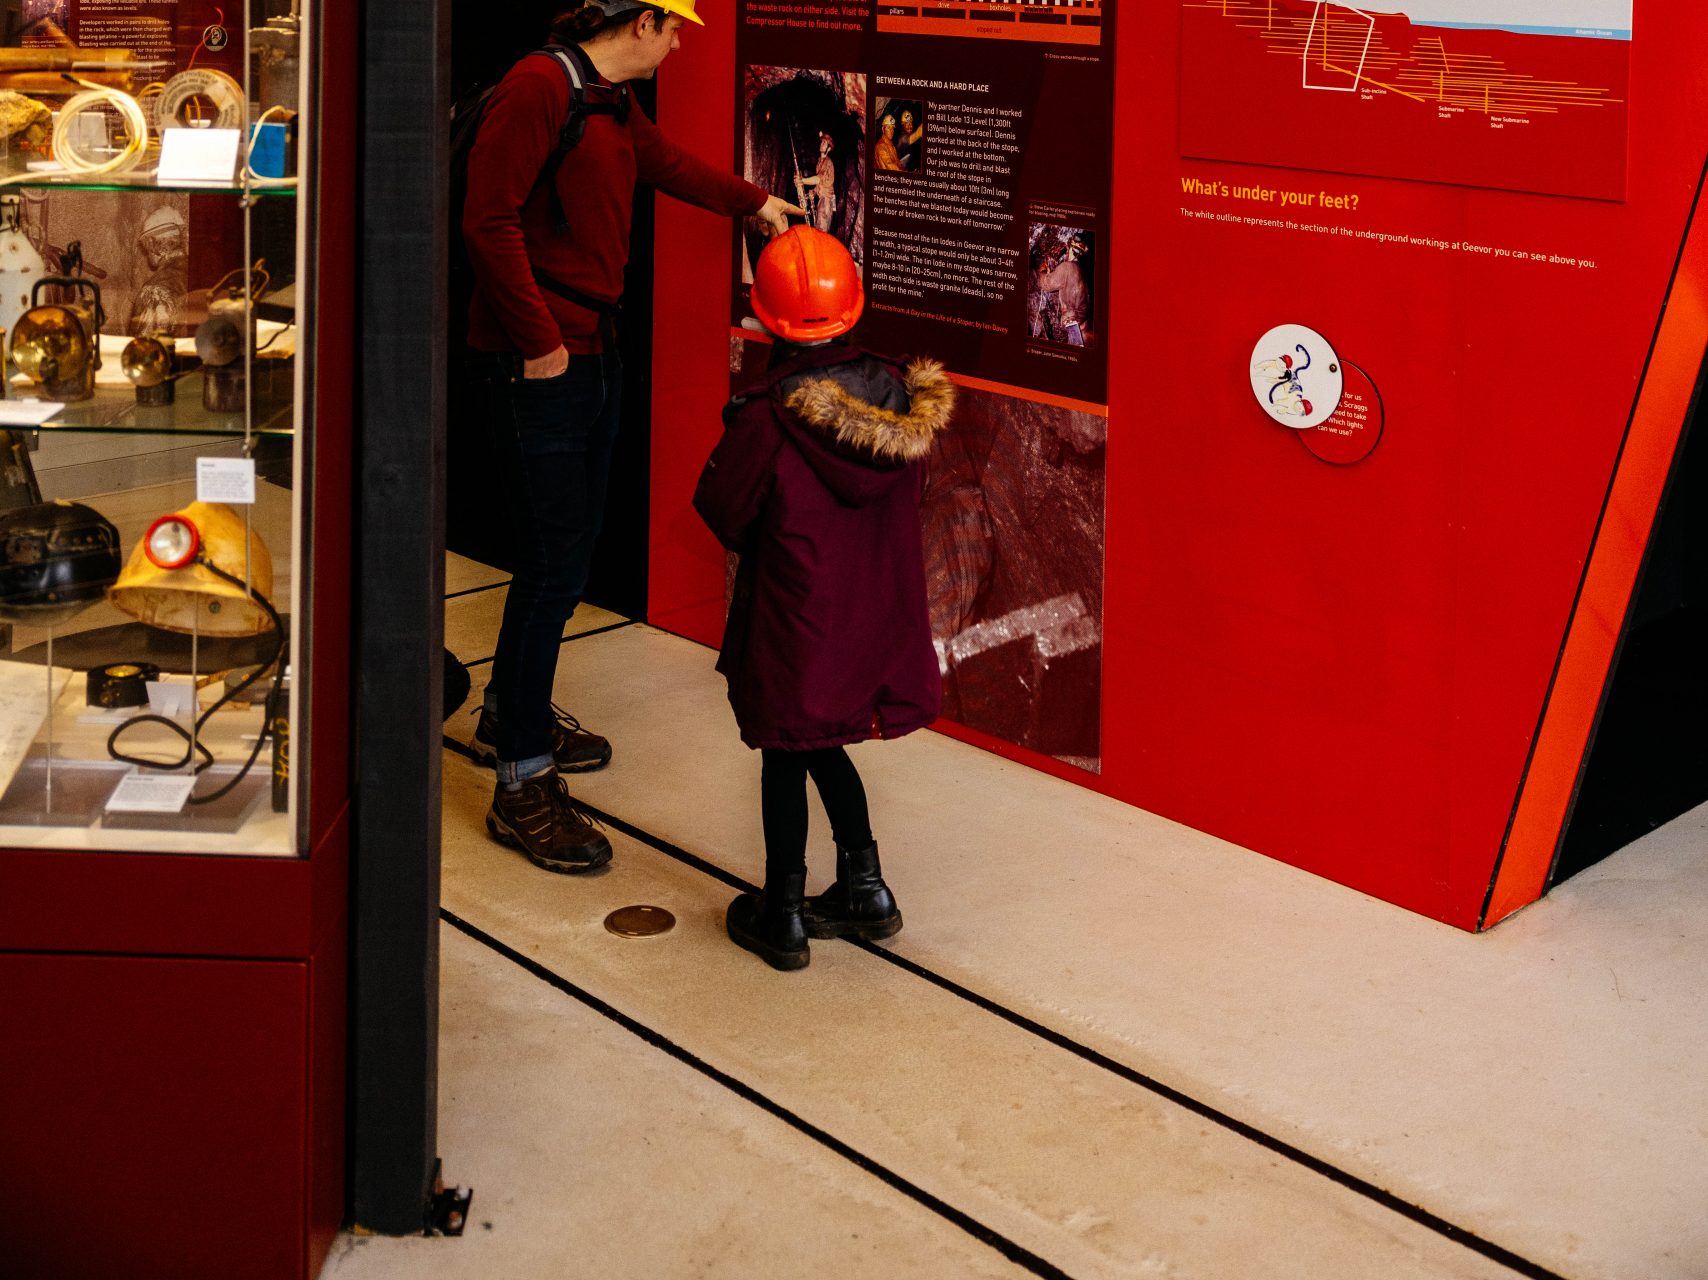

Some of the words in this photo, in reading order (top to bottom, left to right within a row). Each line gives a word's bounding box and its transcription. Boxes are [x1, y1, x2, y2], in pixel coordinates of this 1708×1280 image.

[876, 76, 905, 85] BETWEEN
[912, 79, 928, 88] ROCK
[929, 81, 943, 89] AND
[950, 82, 967, 91] HARD
[968, 84, 989, 92] PLACE
[938, 103, 960, 112] partner
[961, 104, 982, 114] Dennis
[983, 107, 994, 115] and
[1000, 108, 1022, 118] worked
[936, 113, 946, 121] Bill
[947, 115, 962, 123] Lode
[964, 116, 970, 124] 13
[972, 117, 988, 126] Level
[948, 126, 965, 135] below
[995, 130, 1016, 140] Dennis
[1233, 185, 1277, 202] under
[1280, 191, 1315, 207] your
[1319, 192, 1359, 210] feet?
[1180, 207, 1194, 217] The
[1195, 210, 1215, 220] white
[1216, 213, 1242, 223] outline
[1243, 216, 1284, 228] represents
[1286, 221, 1298, 230] the
[1300, 222, 1328, 233] section
[1330, 226, 1338, 235] of
[1340, 227, 1353, 237] the
[1355, 230, 1408, 243] underground
[1410, 237, 1450, 250] workings
[1451, 242, 1460, 250] at
[1462, 242, 1492, 254] Geevor
[1494, 247, 1510, 257] you
[1512, 250, 1528, 259] can
[1530, 252, 1547, 262] see
[1549, 254, 1576, 266] above
[1578, 258, 1598, 269] you.
[1344, 401, 1368, 412] Scraggs
[1354, 412, 1366, 420] take
[1347, 420, 1363, 429] lights
